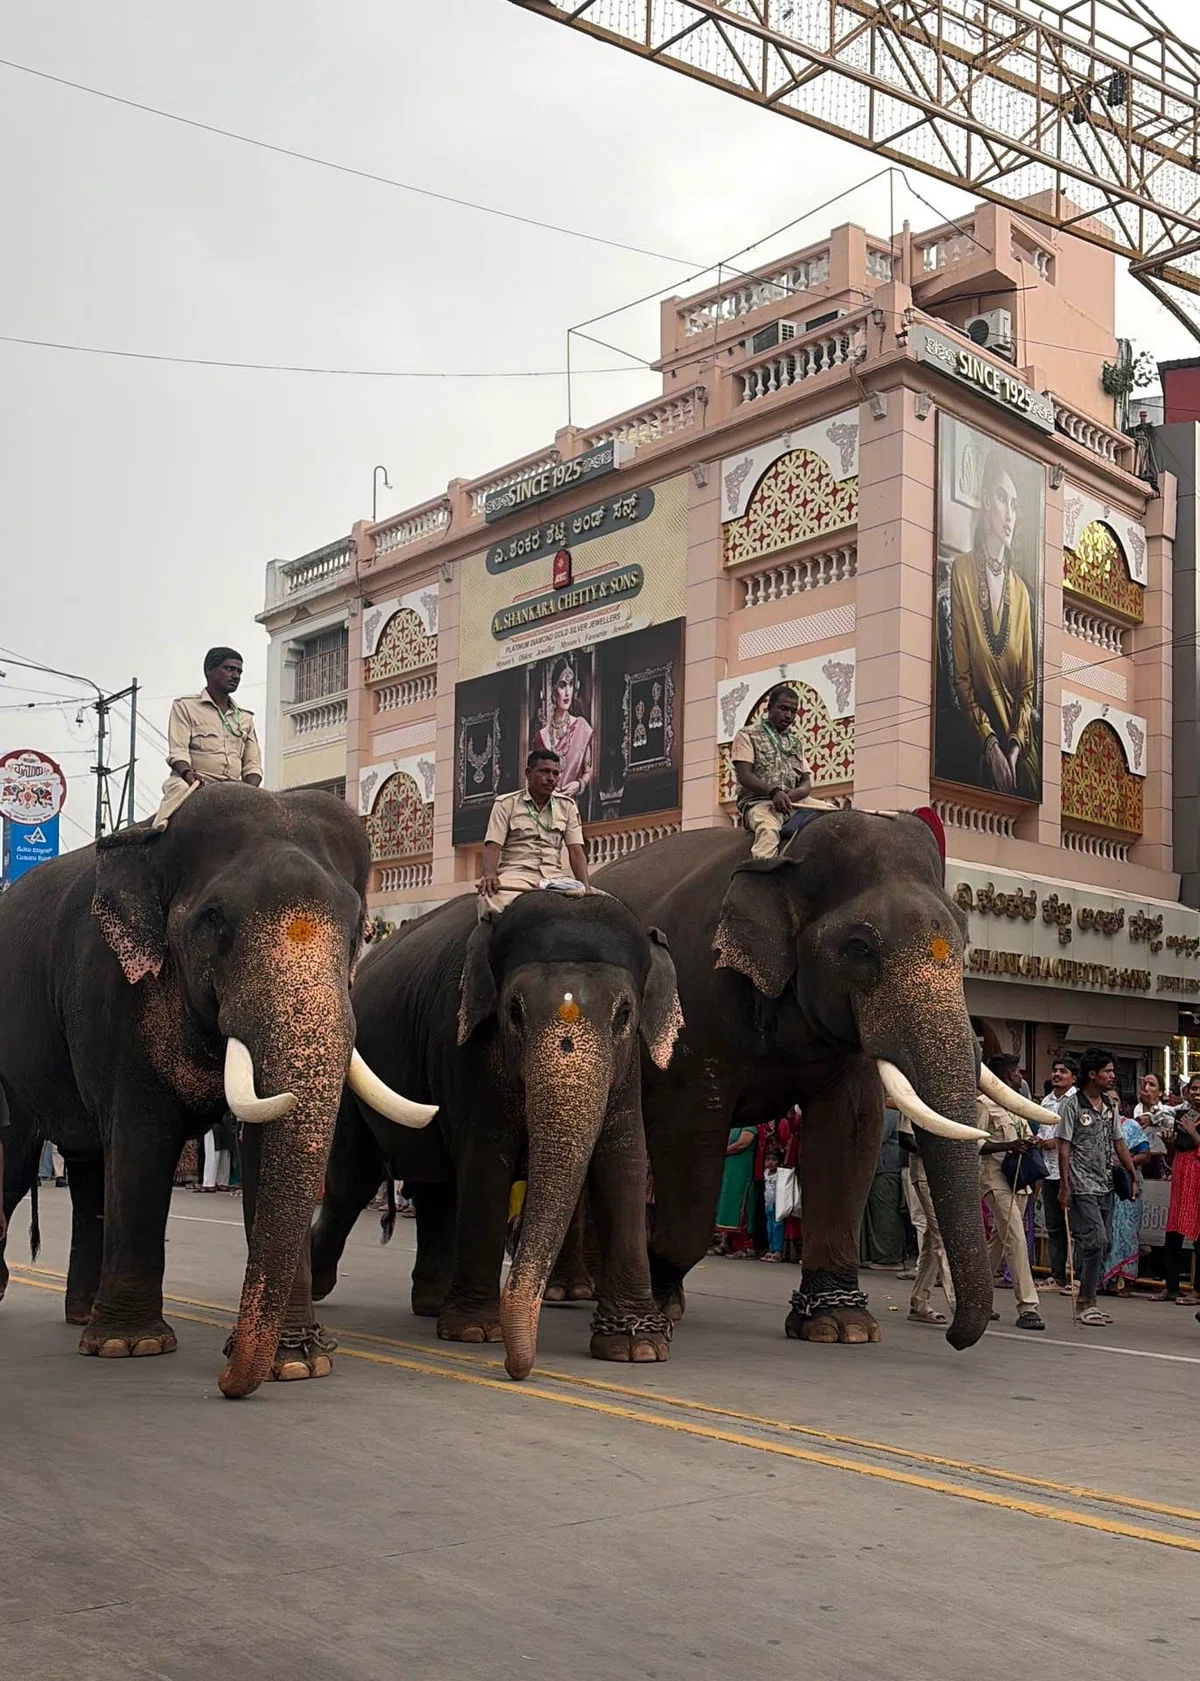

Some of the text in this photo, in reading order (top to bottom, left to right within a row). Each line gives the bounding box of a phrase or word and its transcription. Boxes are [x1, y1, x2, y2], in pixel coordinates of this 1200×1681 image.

[958, 351, 1033, 411] SINCE 1925
[508, 460, 582, 506] SINCE 1925
[572, 505, 605, 534] ಅಂಡ್
[557, 585, 597, 611] CHETTY
[599, 583, 608, 598] &
[610, 571, 639, 593] SONS
[505, 613, 621, 654] PLATINUM DIAMOND GOLD SILVER JEWELLERS
